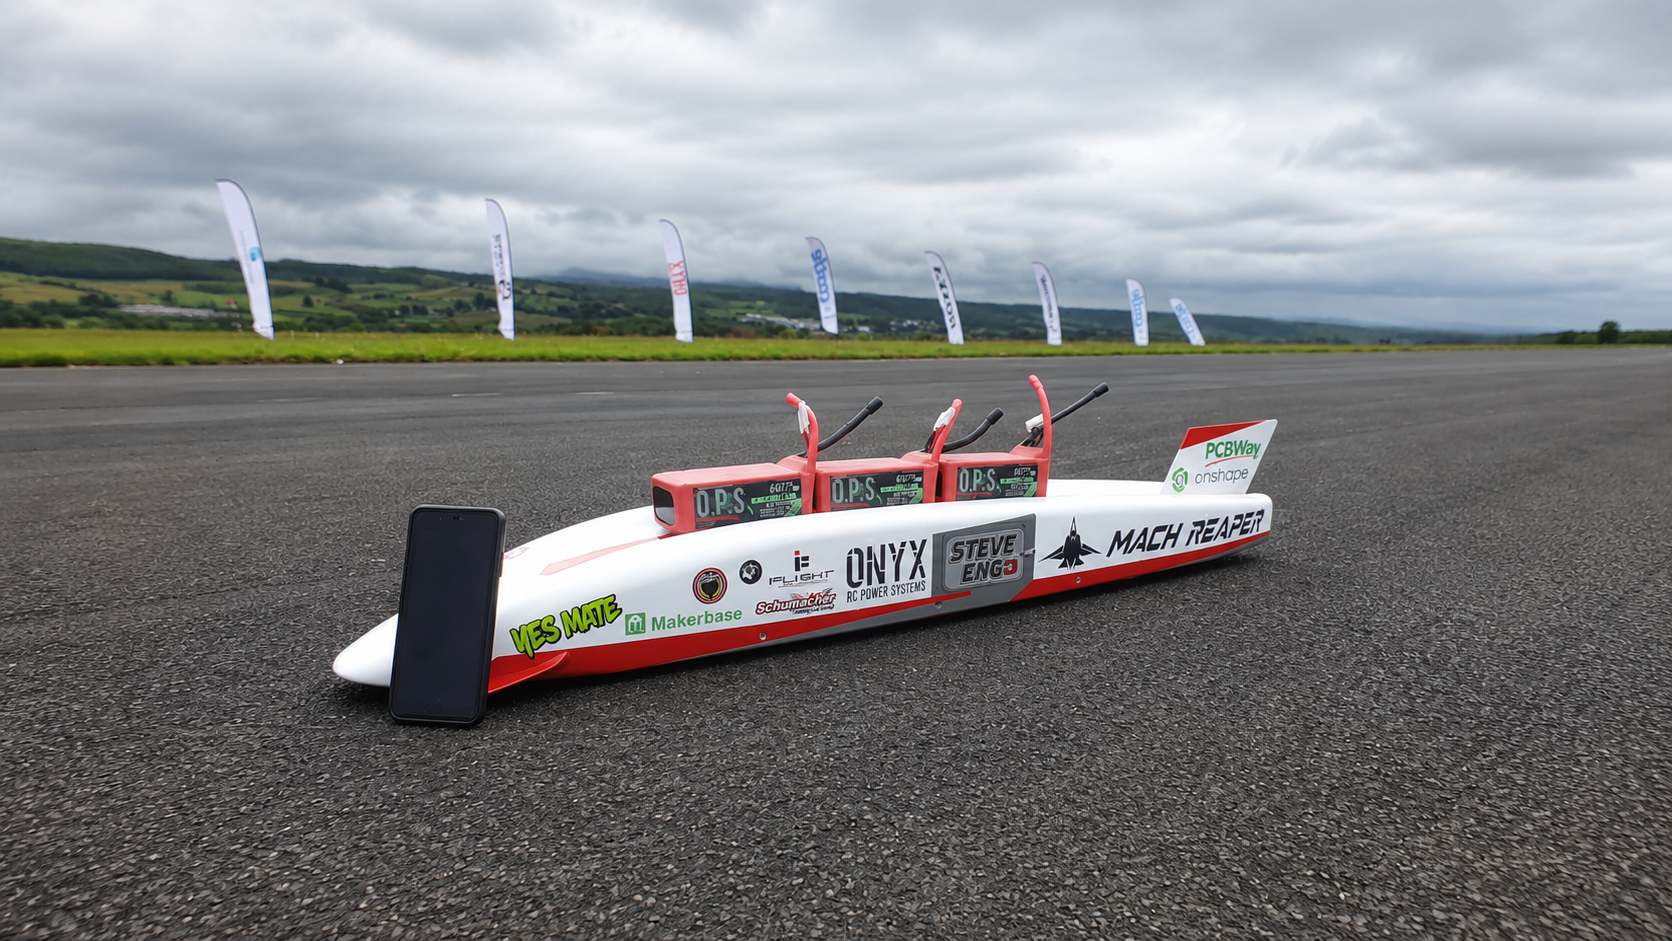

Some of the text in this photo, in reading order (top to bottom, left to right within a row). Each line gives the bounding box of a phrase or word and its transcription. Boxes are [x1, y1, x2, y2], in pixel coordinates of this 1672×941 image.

[1205, 440, 1261, 459] PCBWay
[1195, 468, 1249, 484] onshape
[1106, 509, 1265, 557] MACH REAPER
[949, 534, 1018, 562] STEVE
[846, 539, 927, 588] ONYX
[755, 592, 836, 614] Schumacher
[847, 580, 926, 603] RC POWER SYSTEMS
[510, 594, 622, 659] YES MATE
[651, 609, 743, 631] Makerbase
